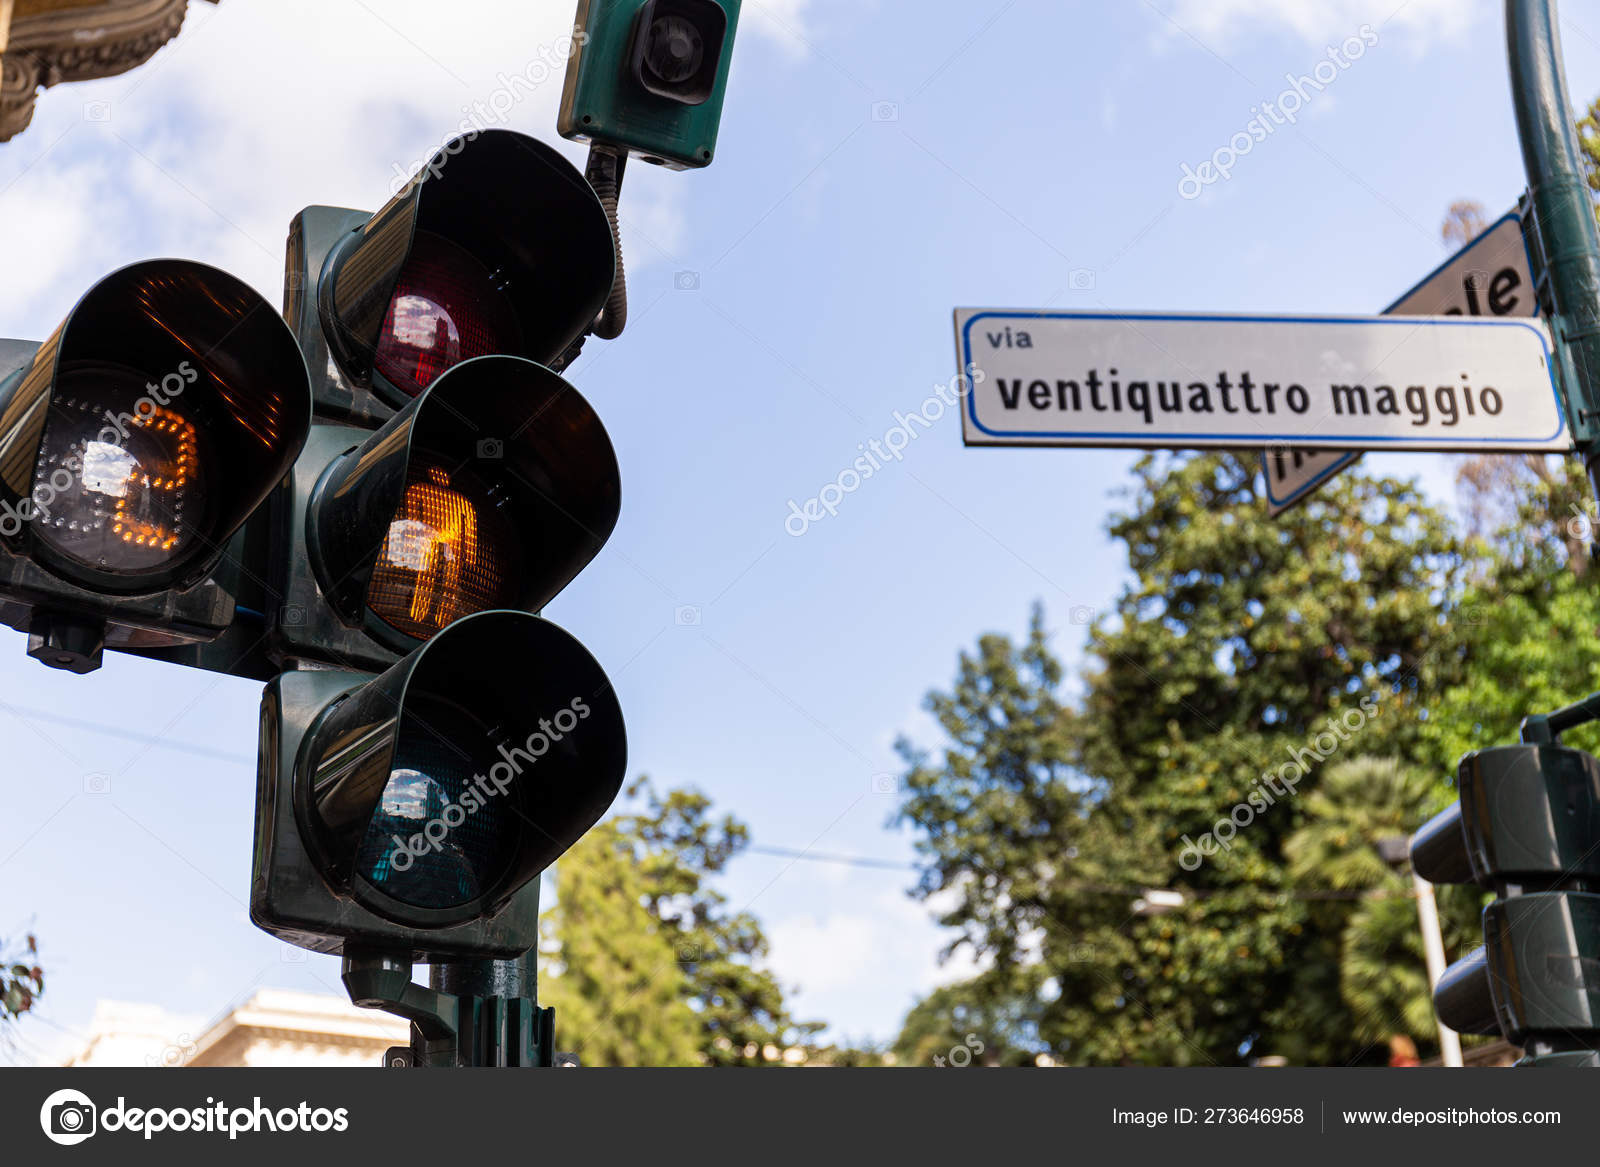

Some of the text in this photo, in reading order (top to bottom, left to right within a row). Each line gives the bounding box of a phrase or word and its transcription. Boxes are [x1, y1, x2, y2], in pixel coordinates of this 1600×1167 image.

[986, 326, 1033, 349] via
[996, 367, 1504, 427] ventiquattro maggio
